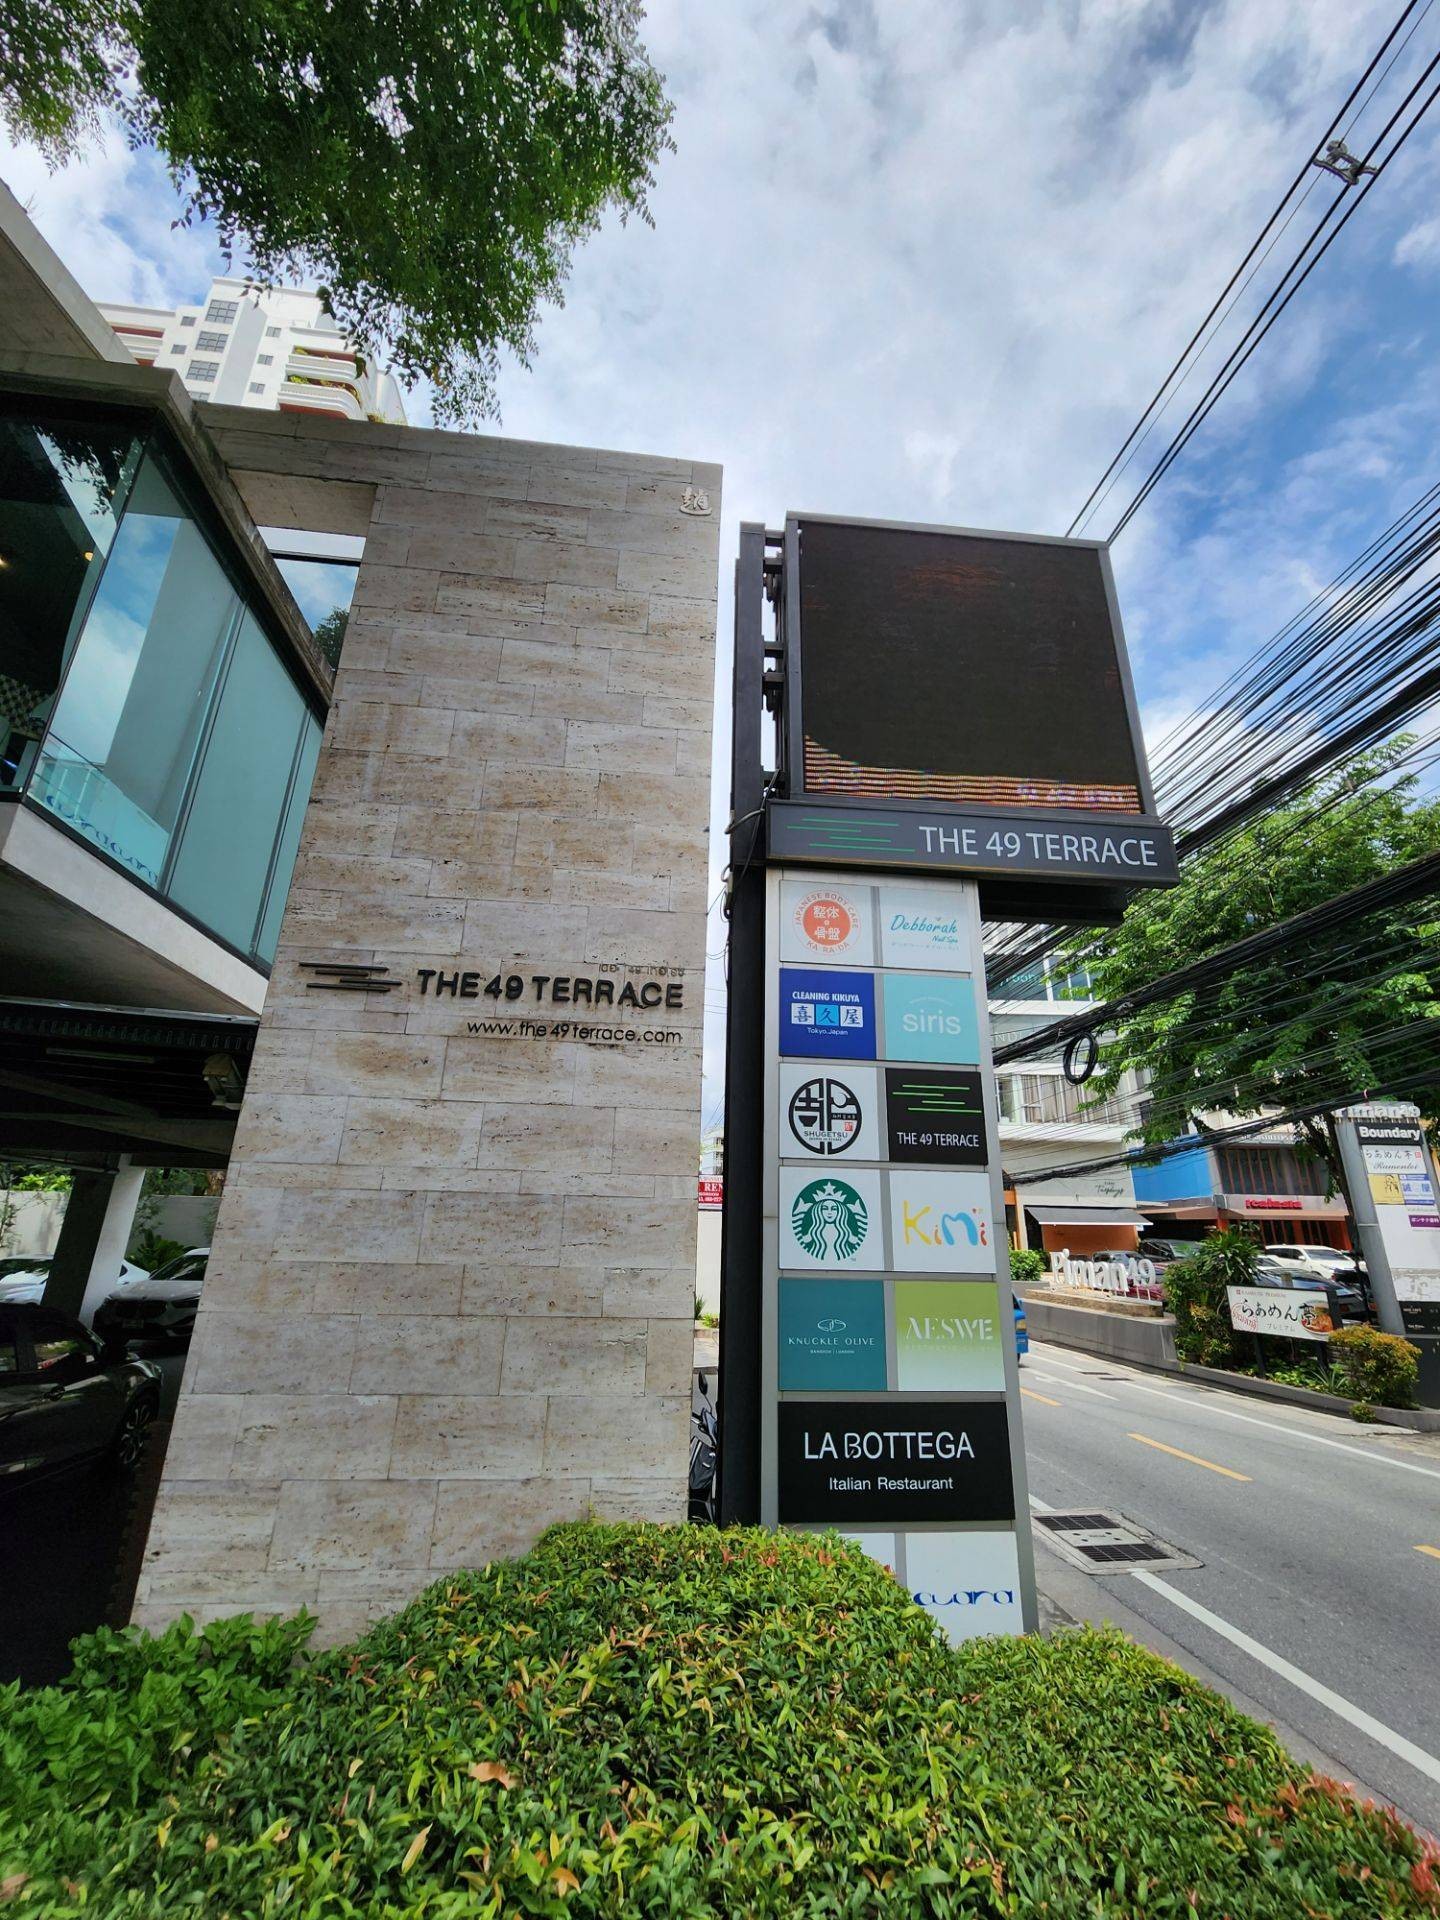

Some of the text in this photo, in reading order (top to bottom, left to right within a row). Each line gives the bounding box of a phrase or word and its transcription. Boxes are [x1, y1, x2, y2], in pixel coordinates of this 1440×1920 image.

[919, 826, 1158, 867] THE 49 TERRACE
[824, 892, 849, 906] BODY
[847, 906, 859, 929] CARE
[890, 914, 958, 934] Debborah
[417, 969, 684, 1008] THE 49 TERRACE
[792, 991, 860, 1003] CLEANING KIKUYA
[794, 1005, 861, 1026] 喜久屋
[902, 1009, 962, 1035] siris
[467, 1020, 682, 1044] www.the49terrace.com
[803, 1131, 848, 1139] SHUGETSU
[897, 1132, 979, 1147] THE 49 TERRACE
[1358, 1126, 1420, 1141] Boundary
[1241, 1298, 1316, 1325] らあめん亭
[788, 1337, 876, 1346] KNUCKLE OLIVE
[804, 1431, 976, 1459] LA BOTTEGA
[829, 1477, 954, 1491] Italian Restaurant
